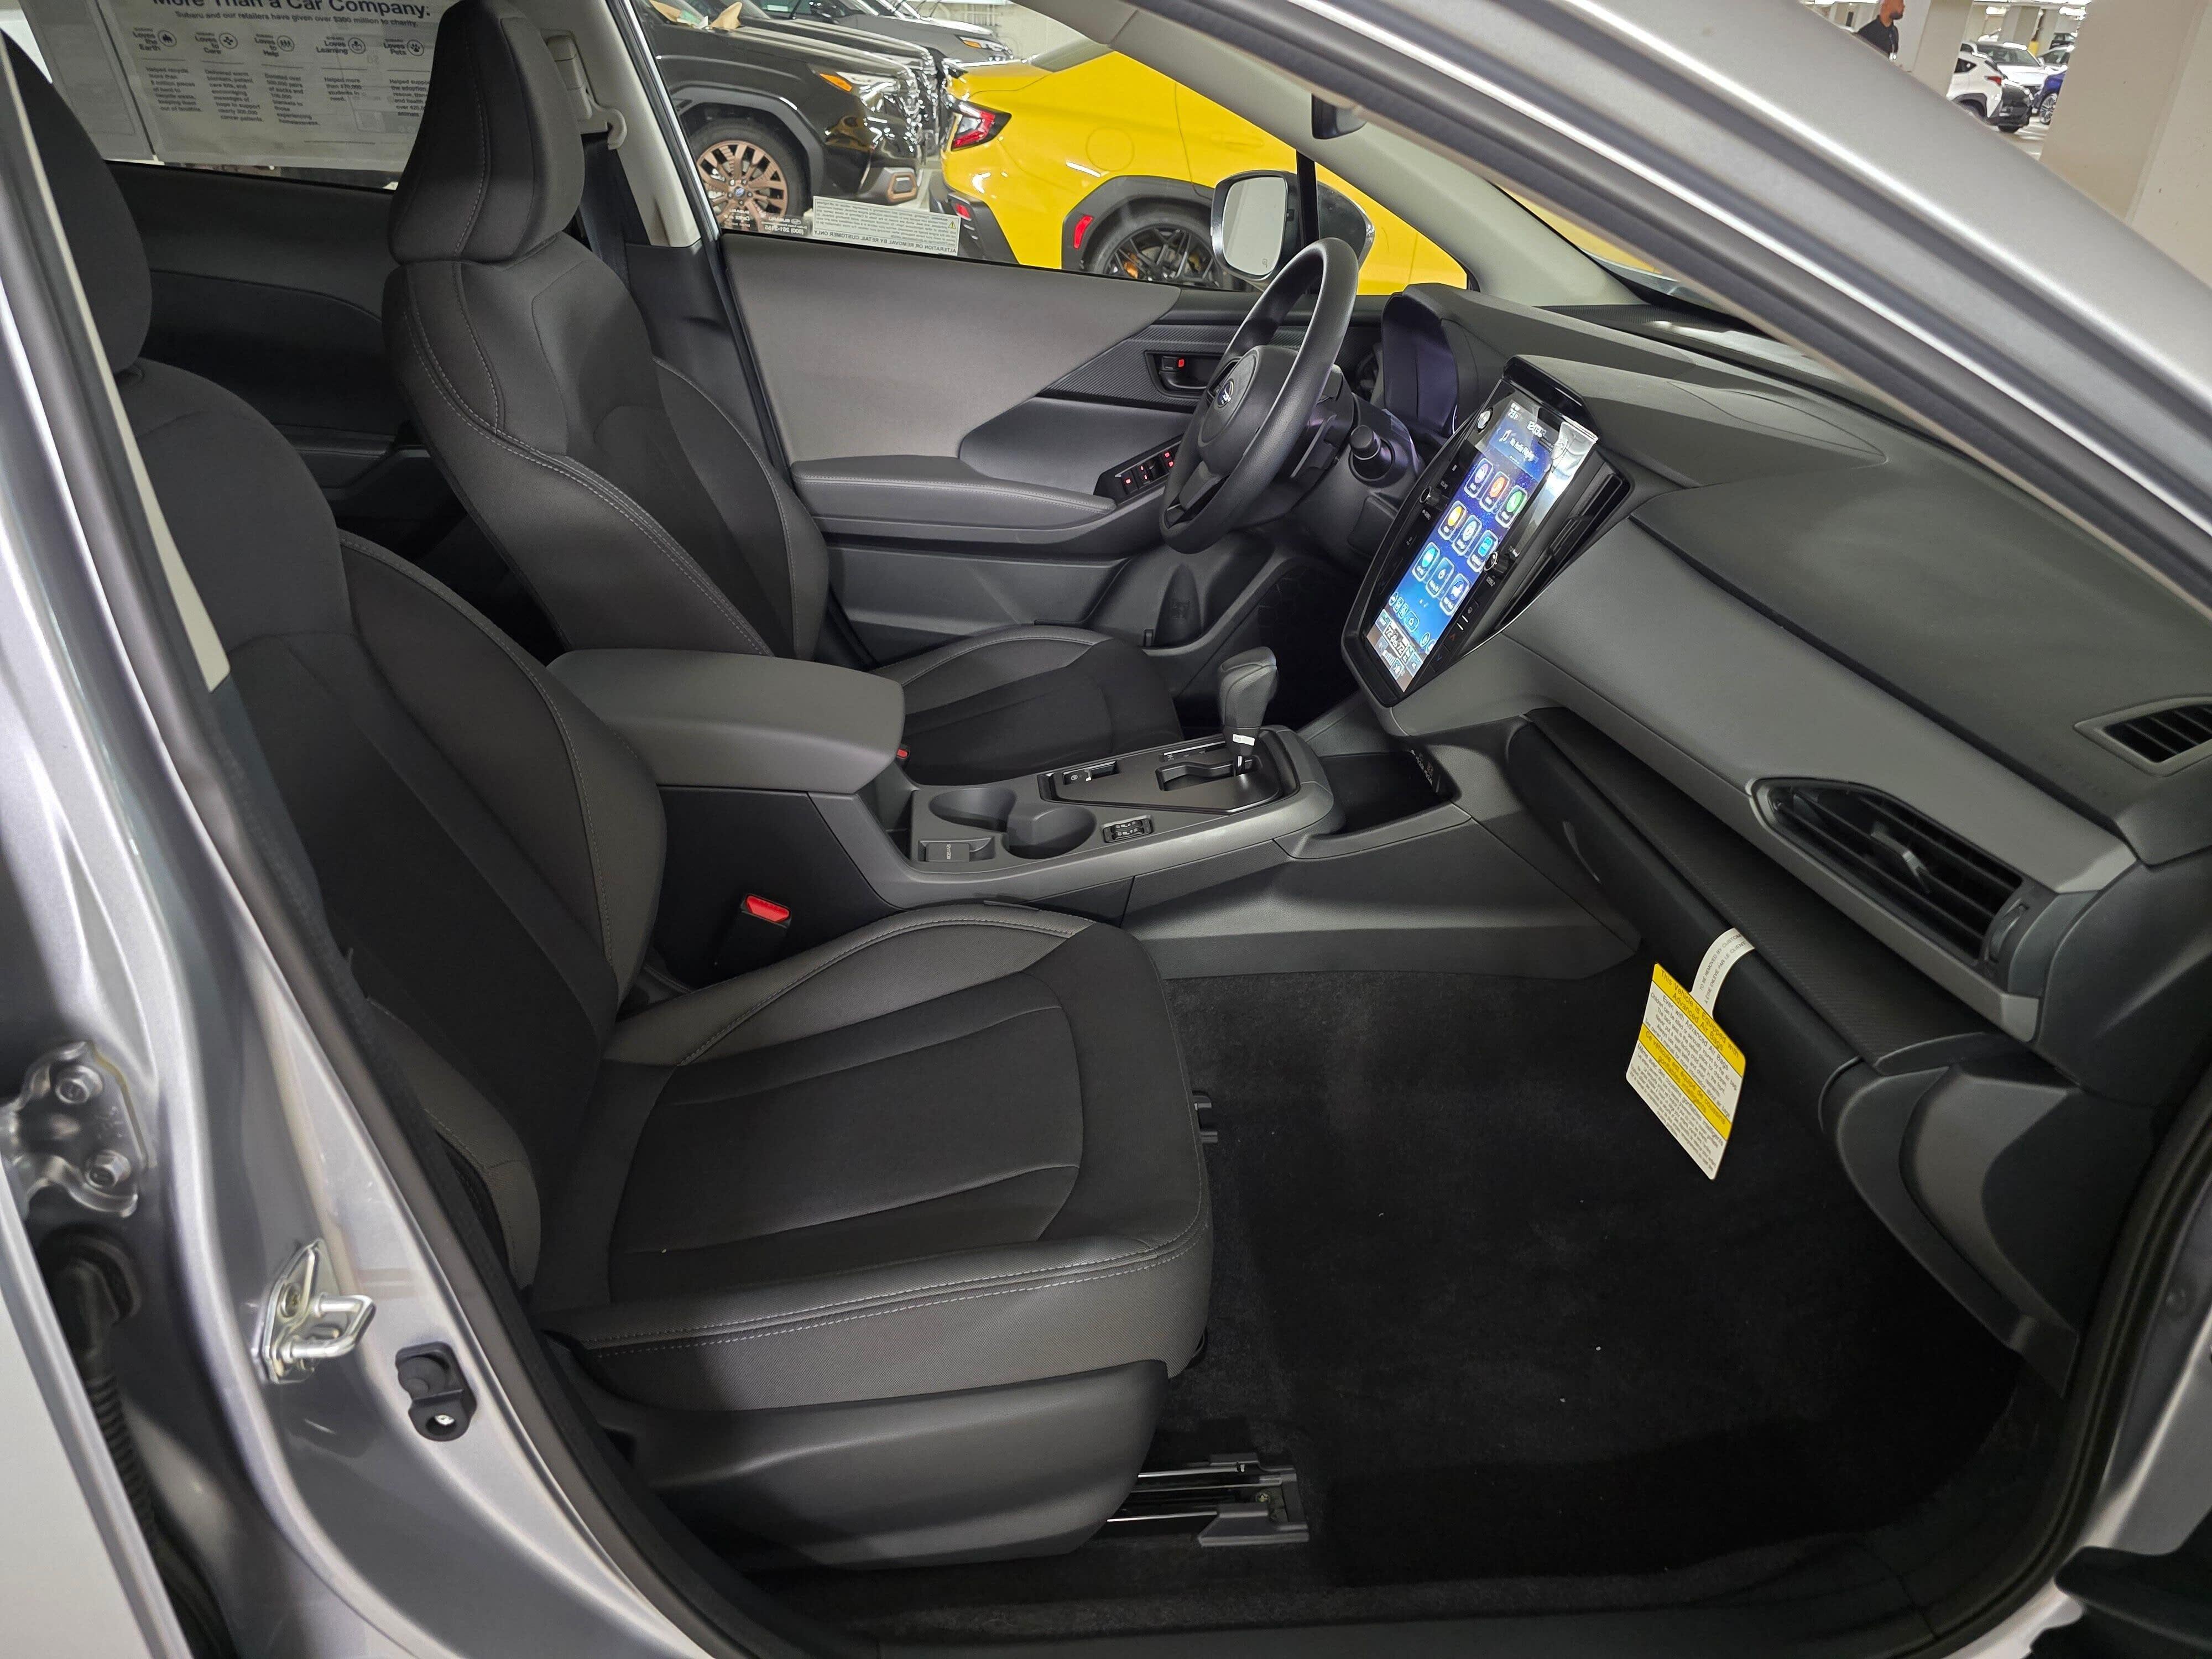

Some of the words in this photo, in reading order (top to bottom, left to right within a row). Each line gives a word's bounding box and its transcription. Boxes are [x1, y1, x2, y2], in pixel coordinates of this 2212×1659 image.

[287, 0, 321, 10] Car
[316, 46, 348, 55] Learning
[1705, 955, 1717, 977] REMOVED
[1722, 934, 1742, 948] CUSTOM
[1730, 941, 1746, 953] CLIENT
[1651, 992, 1663, 1008] Children
[1674, 1018, 1683, 1030] killed
[1713, 1060, 1718, 1070] by
[1655, 1014, 1665, 1027] Never
[1661, 970, 1672, 986] This
[1674, 983, 1692, 1007] Vehicle
[1695, 1005, 1699, 1014] is
[1700, 1012, 1726, 1044] Equipped
[1728, 1042, 1739, 1058] with
[1662, 994, 1674, 1010] Even
[1675, 1008, 1684, 1021] with
[1685, 1019, 1708, 1047] Advanced
[1716, 1053, 1729, 1072] Bags
[1672, 992, 1698, 1024] Advanced
[1699, 1020, 1708, 1034] Air
[1709, 1031, 1723, 1052] Bags
